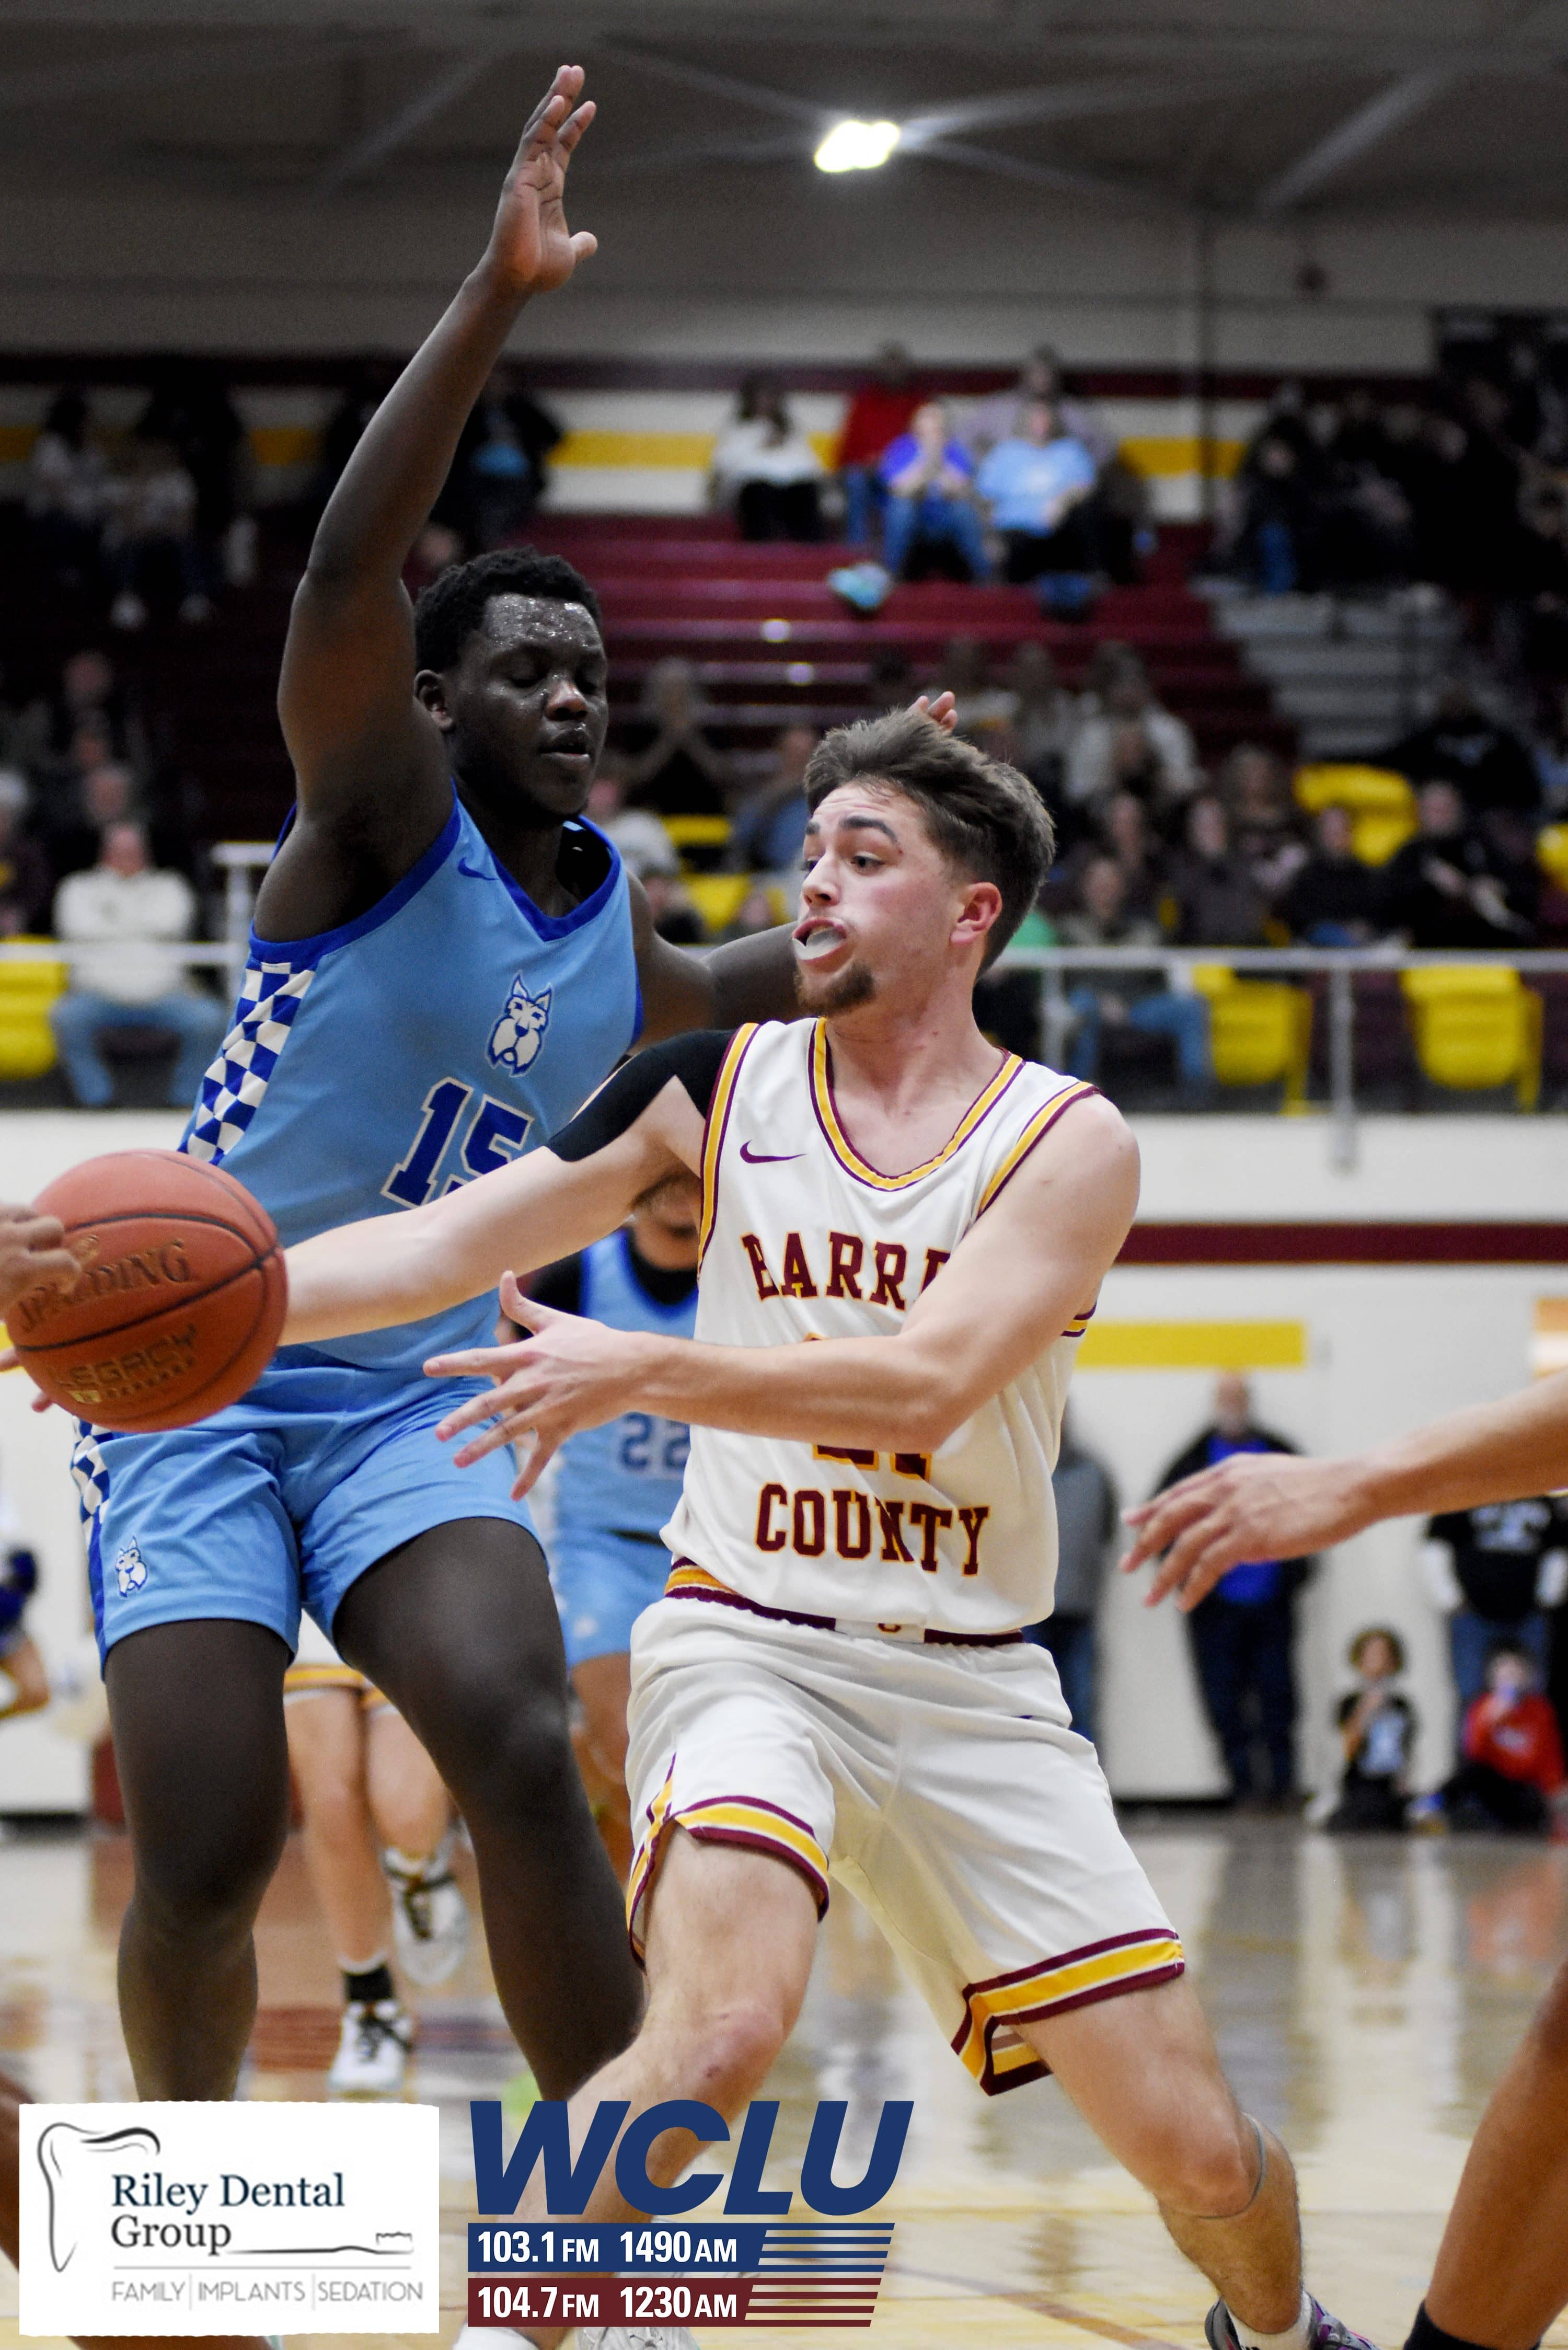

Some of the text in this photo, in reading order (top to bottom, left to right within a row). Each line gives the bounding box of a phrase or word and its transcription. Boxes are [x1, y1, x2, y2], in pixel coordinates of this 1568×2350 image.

[381, 1076, 534, 1209] 15
[617, 1411, 691, 1471] 22
[755, 1483, 990, 1577] COUNTY
